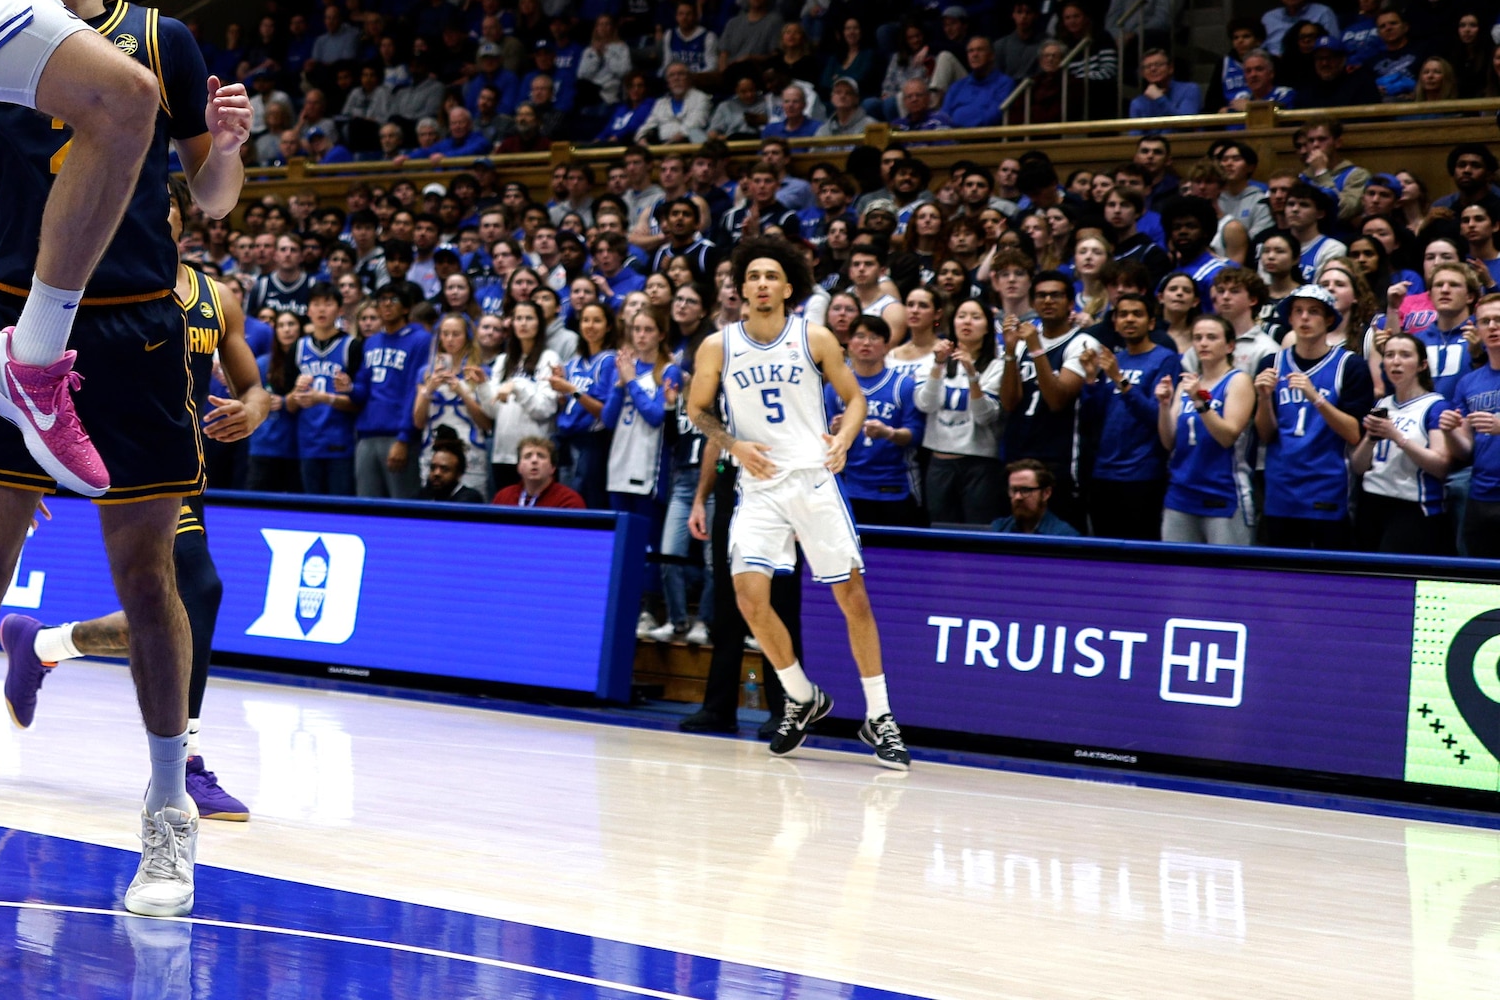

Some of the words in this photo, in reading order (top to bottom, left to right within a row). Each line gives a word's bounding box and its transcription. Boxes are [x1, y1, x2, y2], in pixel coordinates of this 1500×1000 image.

[364, 347, 408, 371] DUKE
[732, 364, 804, 390] DUKE
[760, 388, 786, 424] 5
[1279, 385, 1332, 406] DUE
[1186, 416, 1198, 447] 1
[1294, 407, 1308, 437] 1
[244, 528, 366, 645] D
[927, 615, 1148, 680] TRUIST
